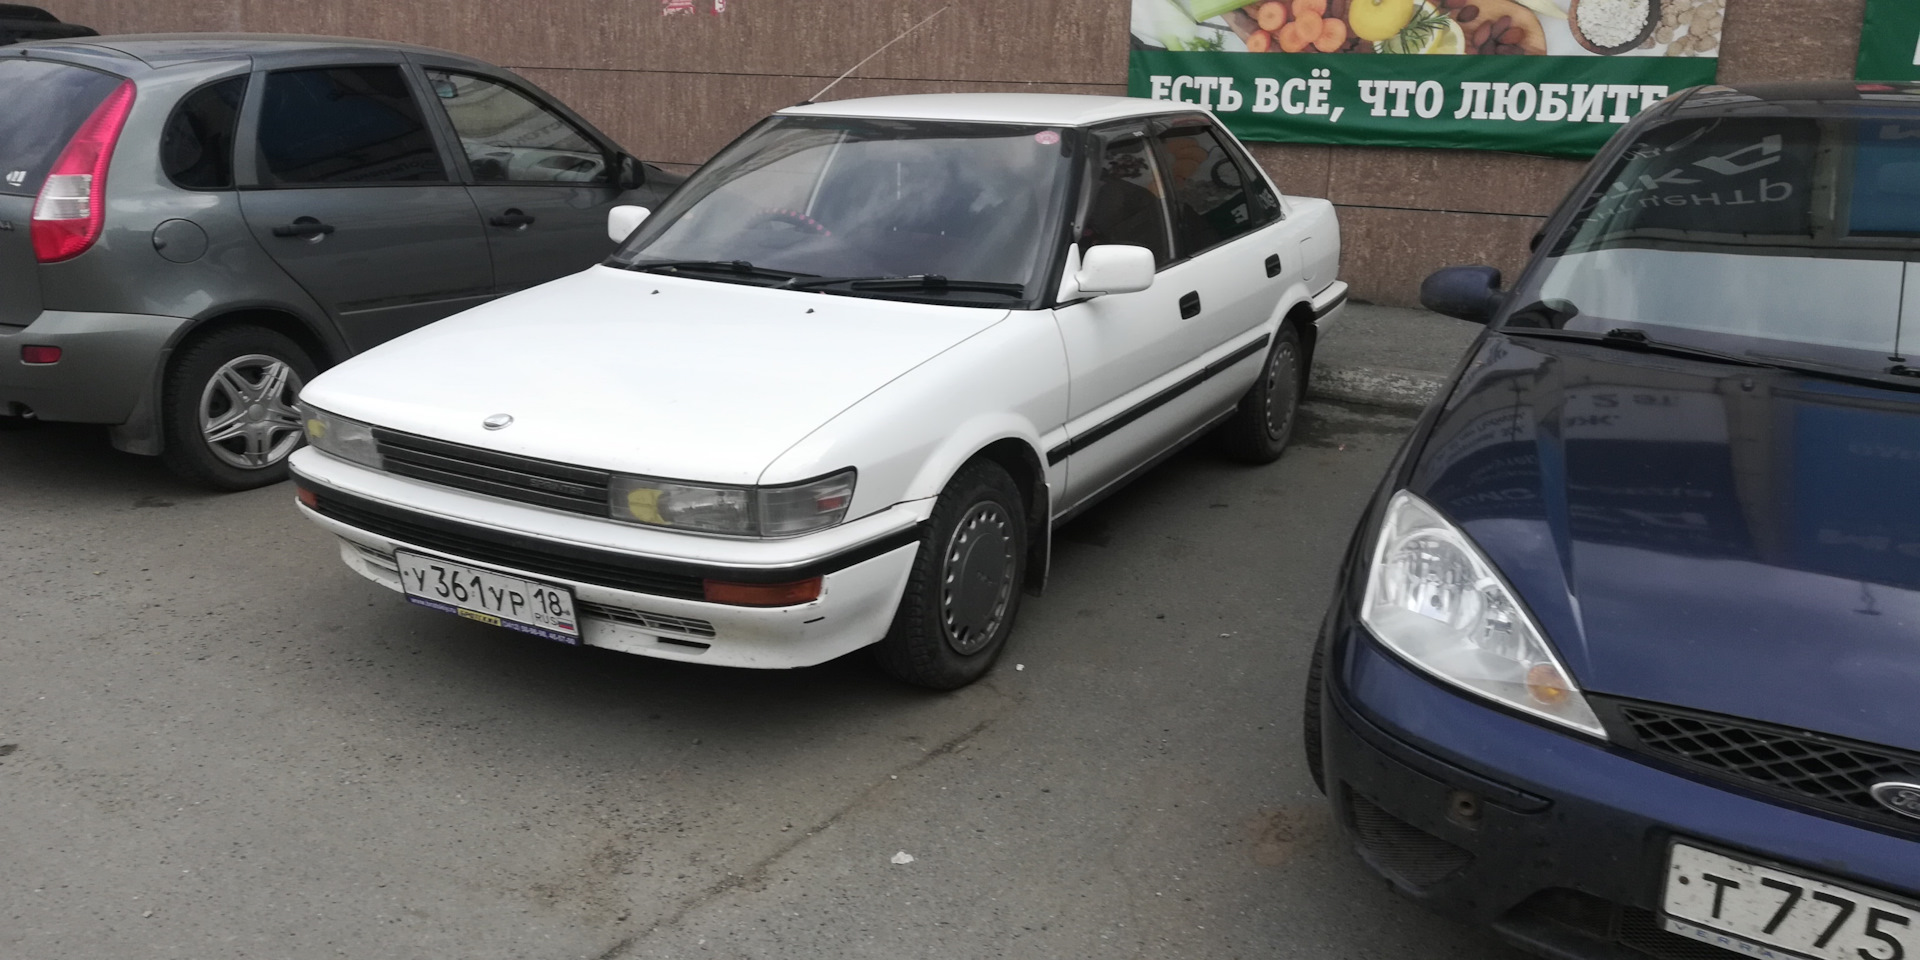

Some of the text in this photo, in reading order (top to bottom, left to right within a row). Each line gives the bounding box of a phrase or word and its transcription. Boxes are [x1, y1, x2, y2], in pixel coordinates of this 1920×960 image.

[1150, 75, 1243, 111] ЕСТЬ
[1252, 69, 1345, 122] ВСЁ,
[1358, 80, 1444, 118] ЧТО
[533, 588, 563, 617] 18
[535, 612, 559, 626] RUS
